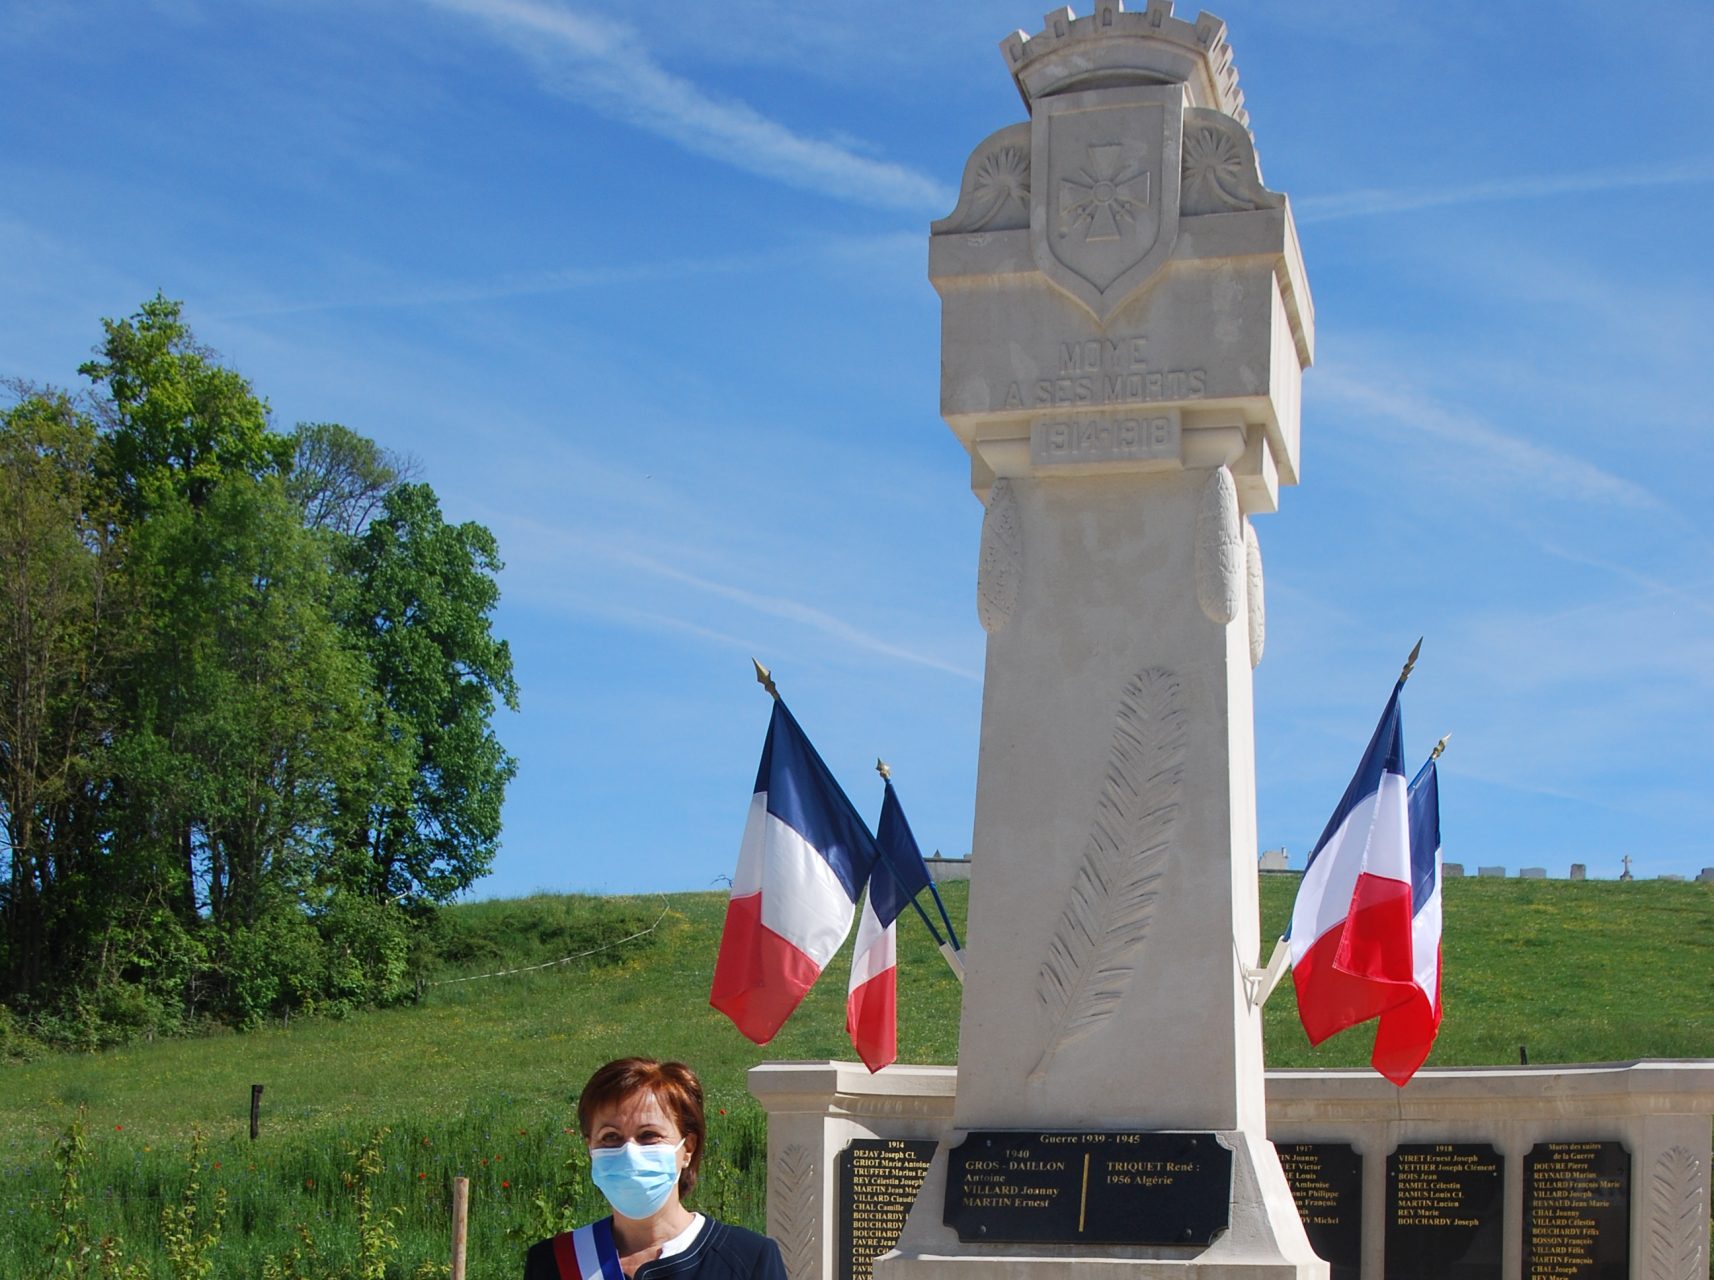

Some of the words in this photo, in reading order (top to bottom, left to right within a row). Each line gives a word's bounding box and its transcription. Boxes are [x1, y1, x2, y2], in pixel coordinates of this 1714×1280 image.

[1004, 380, 1024, 409] A
[1036, 377, 1092, 408] SES
[1102, 369, 1207, 404] MORTS
[1040, 1134, 1078, 1144] Guerre
[1081, 1134, 1105, 1144] 1939
[1116, 1135, 1140, 1144] 1945
[880, 1151, 904, 1159] Joseph
[1006, 1149, 1030, 1159] 1940
[1293, 1155, 1318, 1163] Joanny
[1453, 1155, 1478, 1163] Joseph
[965, 1161, 1000, 1171] GROS
[1009, 1161, 1065, 1171] DAILLON
[1107, 1162, 1163, 1172] TRIQUET
[1166, 1162, 1193, 1171] René
[964, 1173, 1006, 1182] Antoine
[1107, 1175, 1131, 1184] 1956
[1135, 1175, 1173, 1186] Algérie
[900, 1178, 924, 1187] Joseph
[963, 1186, 1018, 1195] VILLARD
[1020, 1186, 1060, 1197] Joanny
[1309, 1190, 1339, 1198] Philippe
[1569, 1191, 1592, 1199] Joseph
[962, 1198, 1011, 1207] MARTIN
[1015, 1198, 1049, 1207] Ernest
[853, 1212, 904, 1220] BOUCHARDY
[1556, 1210, 1579, 1218] Joanny
[1454, 1219, 1479, 1227] Joseph
[1555, 1266, 1577, 1274] Joseph
